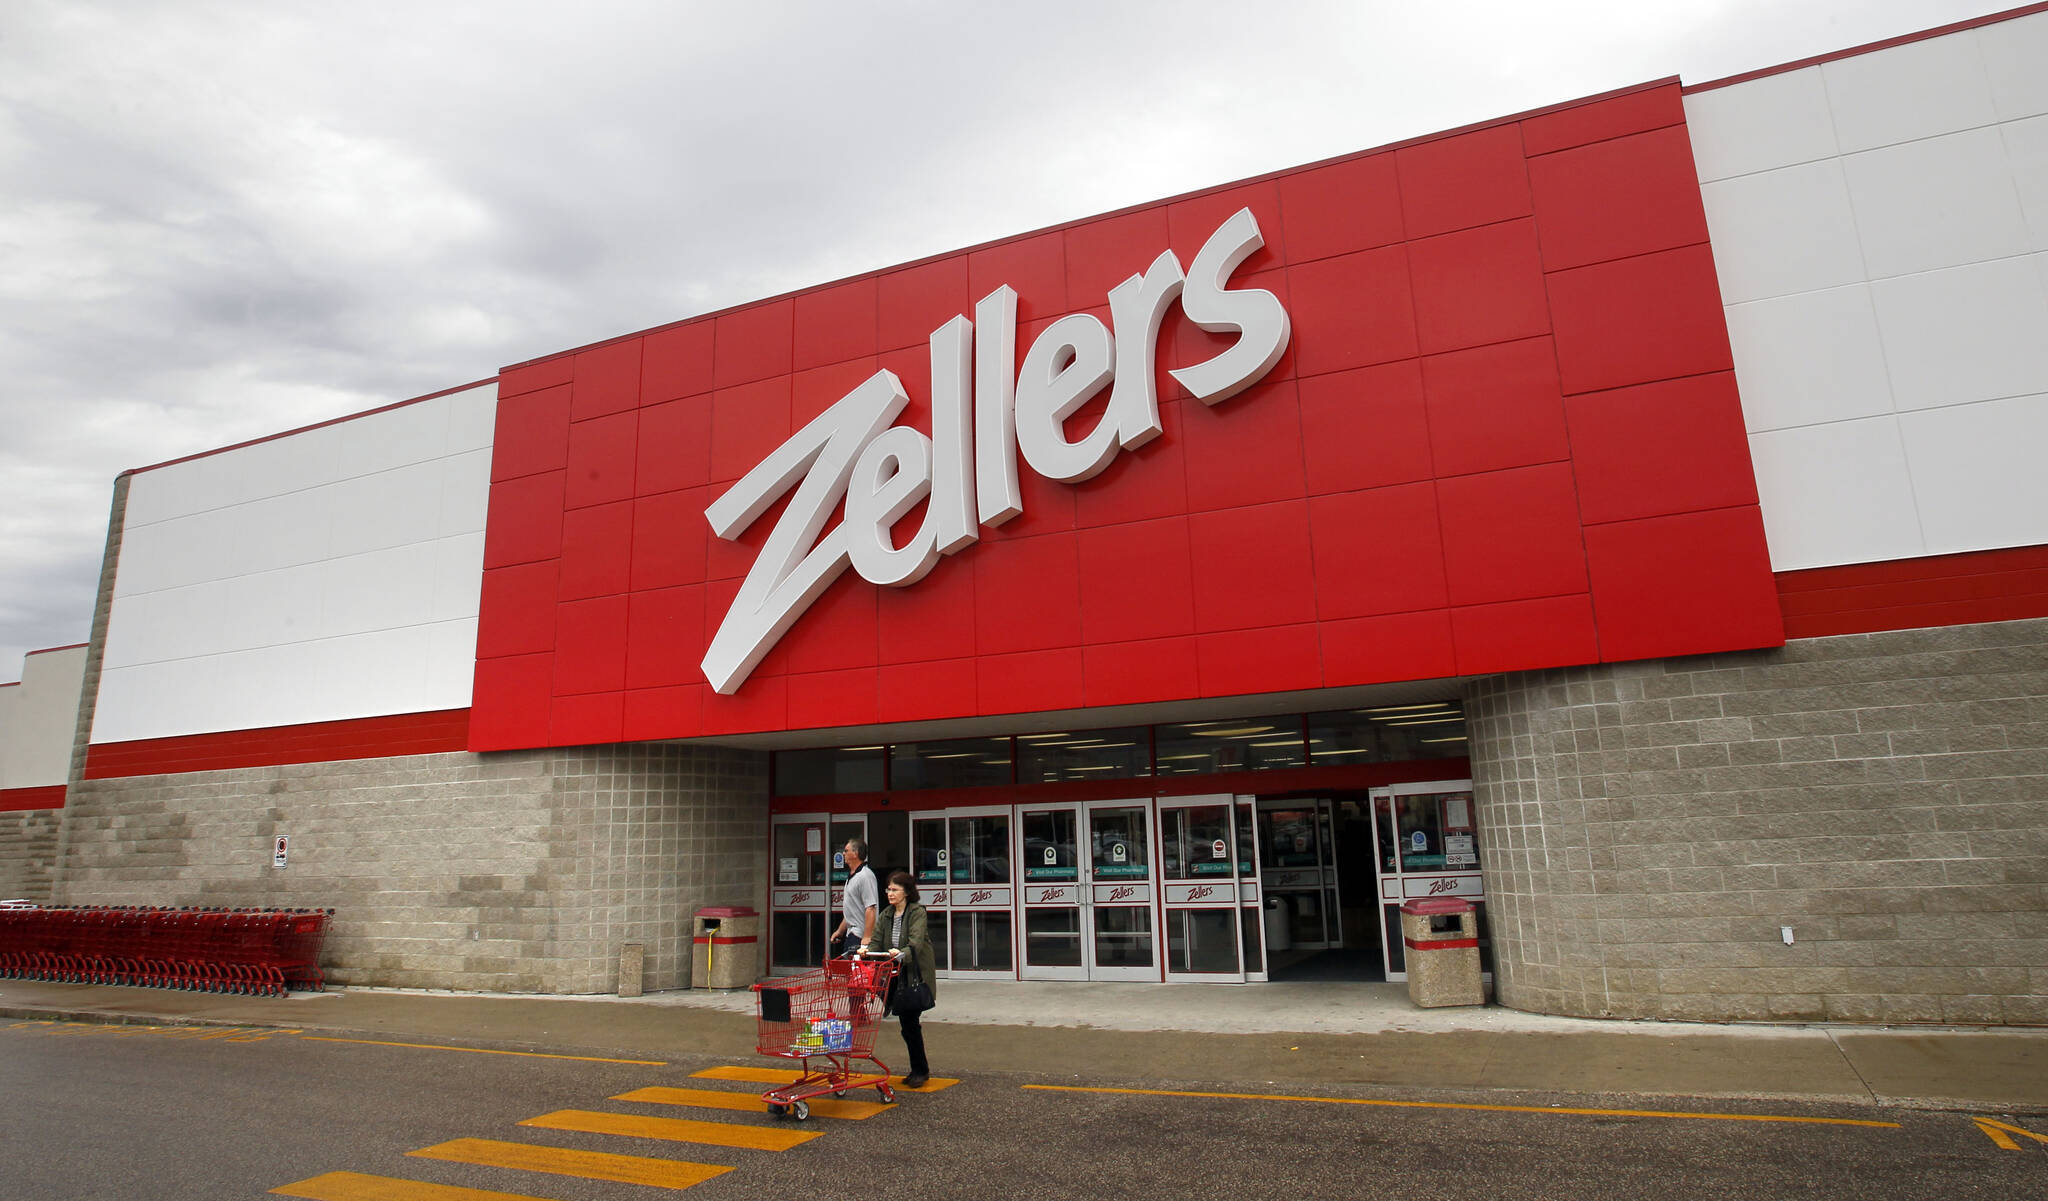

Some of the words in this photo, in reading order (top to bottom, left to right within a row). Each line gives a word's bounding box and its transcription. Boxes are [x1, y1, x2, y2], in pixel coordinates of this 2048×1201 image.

[701, 206, 1291, 695] Zellers
[1041, 887, 1065, 902] Zellers
[1109, 886, 1135, 902] Zellers
[1187, 885, 1213, 902] Zellers
[1429, 879, 1459, 895] Zellers
[790, 891, 810, 905] Zellers
[932, 890, 947, 904] Zell
[969, 889, 993, 904] Zellers
